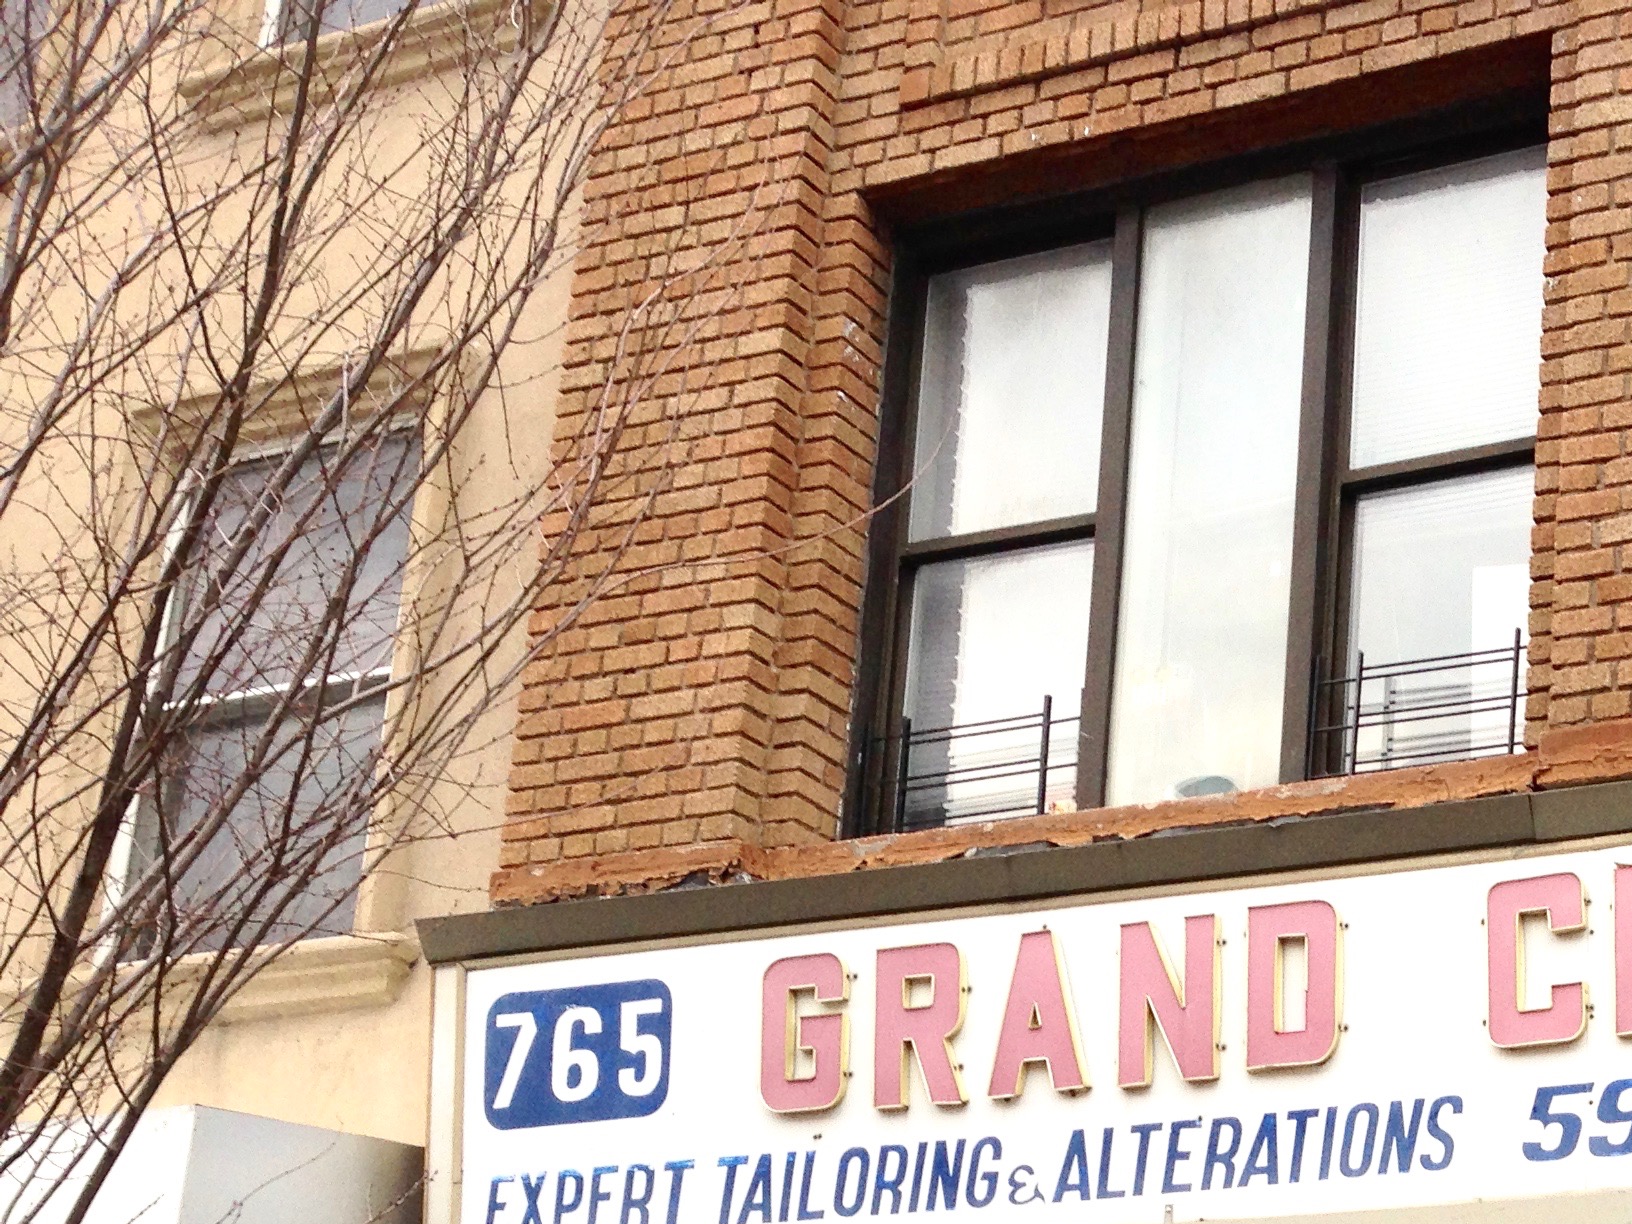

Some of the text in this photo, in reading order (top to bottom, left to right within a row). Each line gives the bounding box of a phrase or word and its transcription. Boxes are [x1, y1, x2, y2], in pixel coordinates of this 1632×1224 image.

[492, 998, 665, 1110] 765
[761, 899, 1344, 1115] GRAND
[1052, 1095, 1464, 1205] ALTERATIONS
